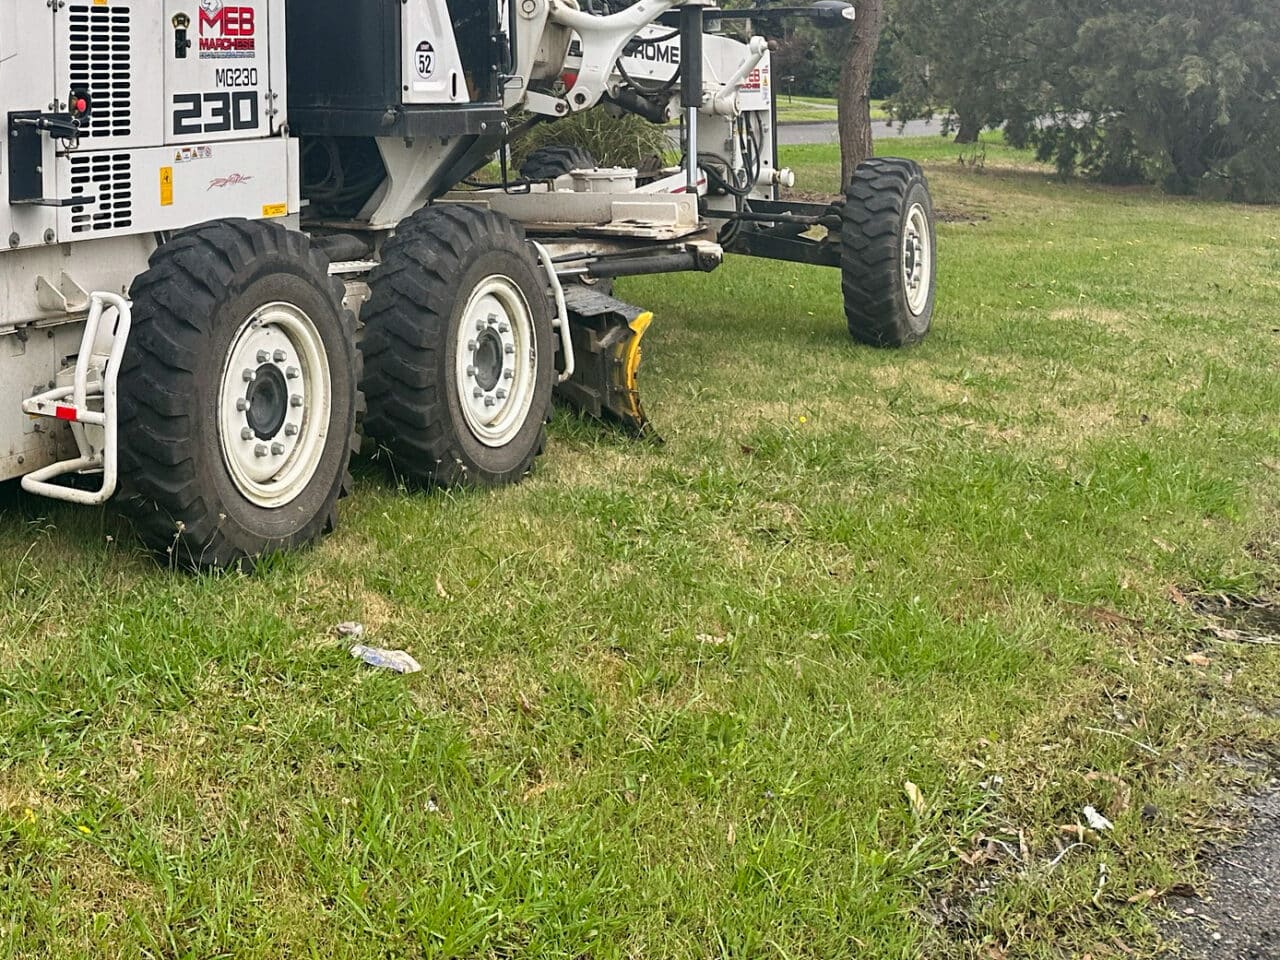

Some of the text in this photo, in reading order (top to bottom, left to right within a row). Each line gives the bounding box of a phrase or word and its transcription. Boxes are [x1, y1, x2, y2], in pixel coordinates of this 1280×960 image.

[199, 6, 255, 37] MEB
[199, 38, 255, 51] MARCHESE
[419, 54, 431, 74] 52
[215, 68, 258, 88] MG230
[173, 91, 259, 135] 230
